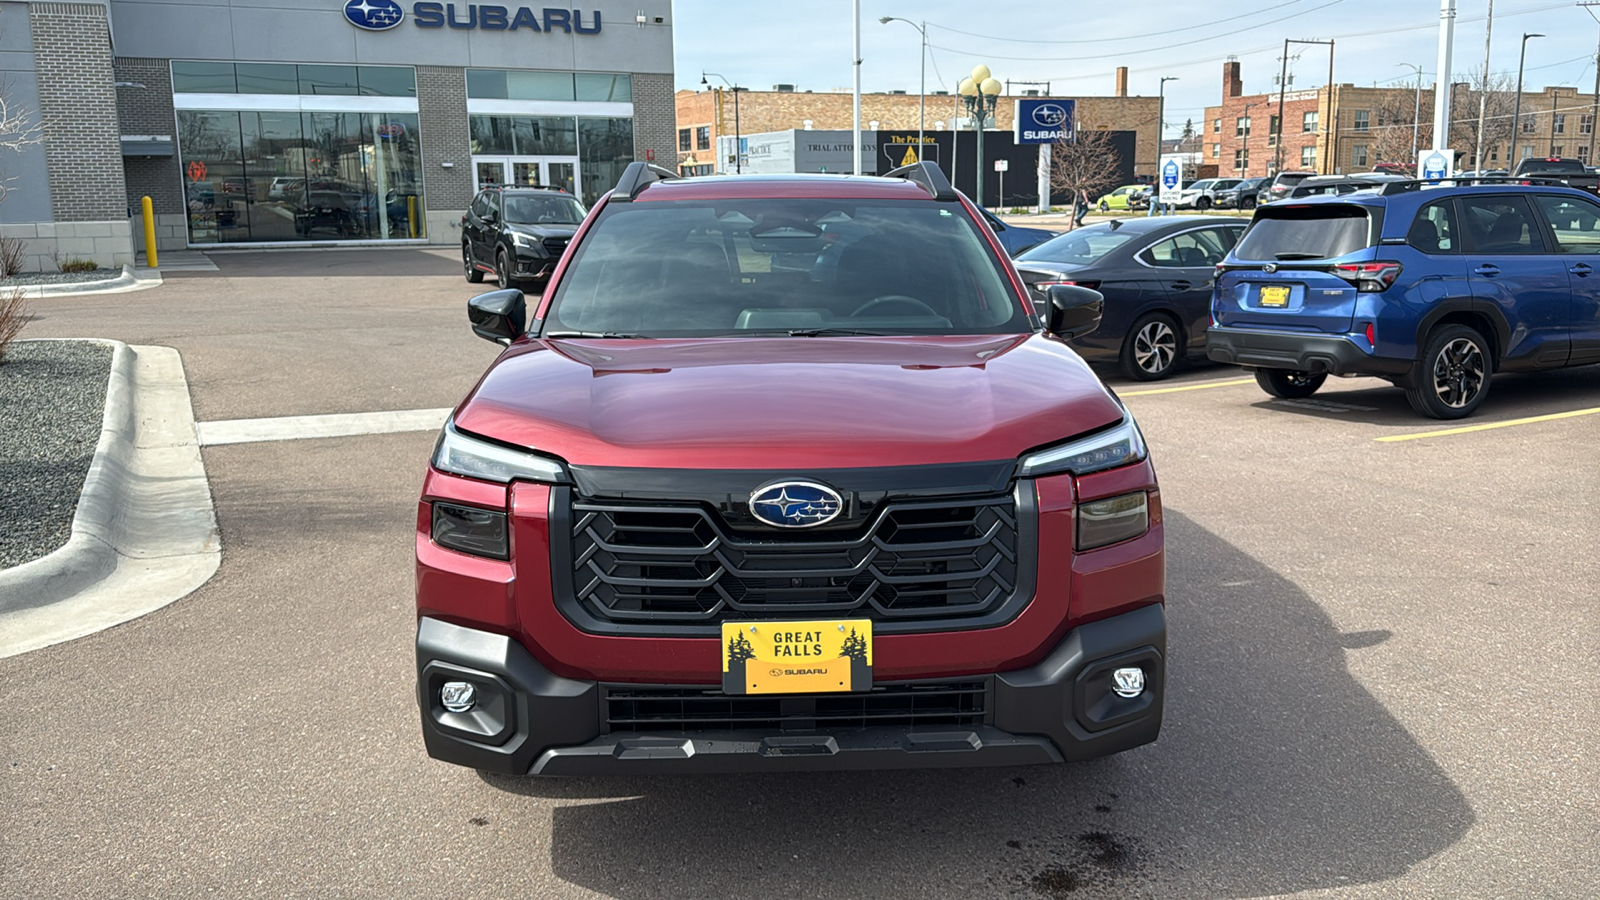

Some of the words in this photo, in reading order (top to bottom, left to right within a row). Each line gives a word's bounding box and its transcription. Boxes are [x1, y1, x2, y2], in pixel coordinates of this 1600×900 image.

[413, 1, 602, 35] SUBARU
[891, 135, 905, 144] The
[906, 135, 936, 144] Pratice
[1023, 130, 1072, 140] SUBARU
[807, 144, 831, 152] TRIAL
[773, 631, 822, 643] GREAT
[774, 644, 822, 657] FALLS
[784, 668, 828, 676] SUBARU
